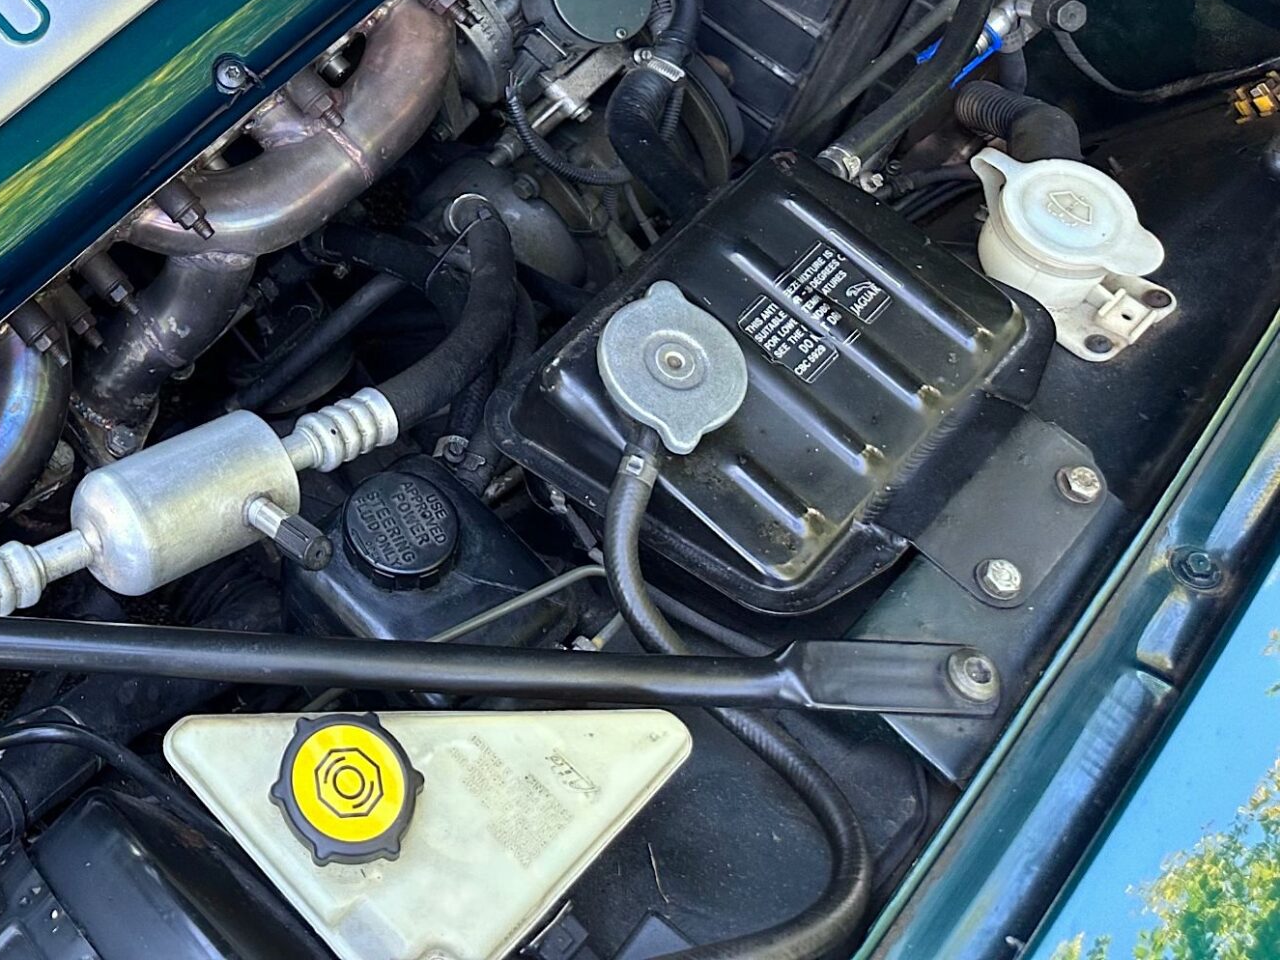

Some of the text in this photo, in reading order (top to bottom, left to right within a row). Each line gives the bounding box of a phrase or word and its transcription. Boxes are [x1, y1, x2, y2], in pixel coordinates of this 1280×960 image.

[745, 318, 764, 335] THIS
[822, 248, 835, 261] IS
[754, 309, 789, 343] SUITABLE
[810, 259, 841, 290] DEGREES
[848, 283, 883, 318] JAGUAR
[764, 335, 781, 352] FOR
[773, 328, 805, 359] SEE THE
[798, 338, 815, 354] DO
[354, 496, 403, 567] FLUID ONLY
[366, 490, 416, 563] STEERING
[391, 492, 431, 547] POWER
[400, 480, 448, 545] APPROVED
[426, 493, 449, 520] USE
